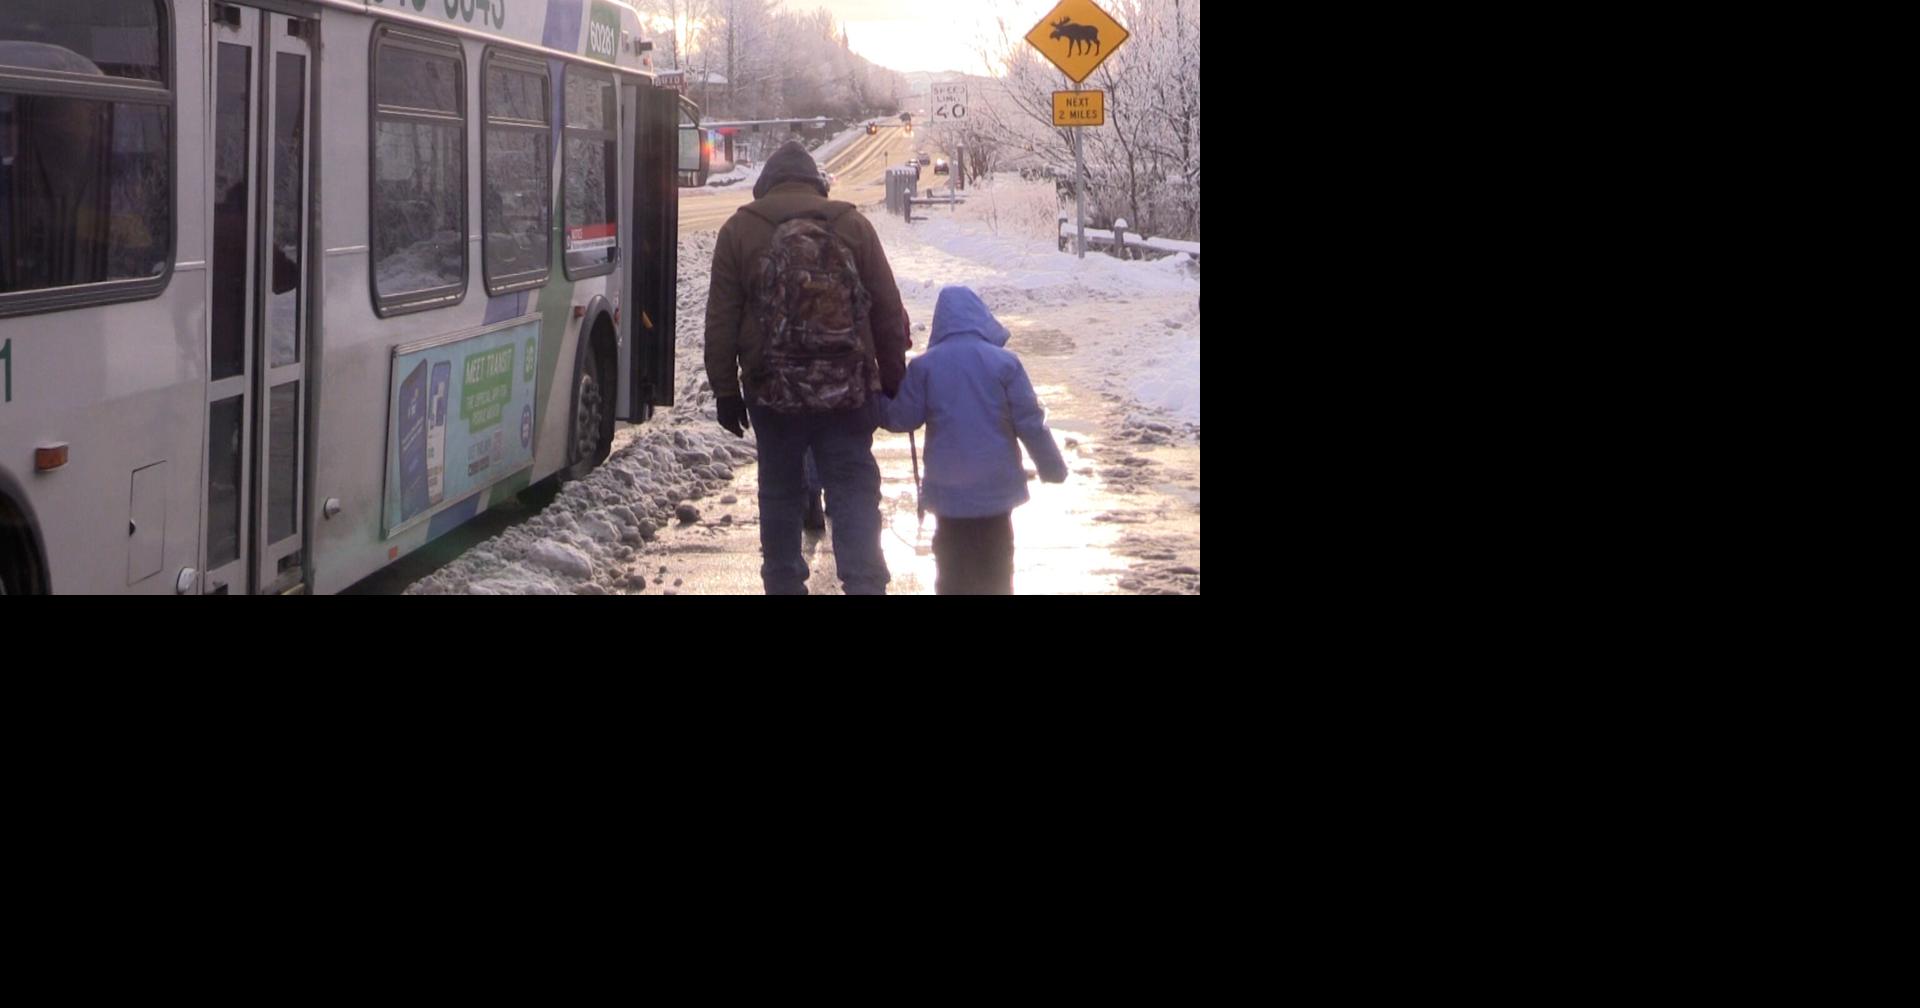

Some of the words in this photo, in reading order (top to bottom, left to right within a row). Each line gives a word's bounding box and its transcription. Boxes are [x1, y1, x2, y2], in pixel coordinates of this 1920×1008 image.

[590, 21, 616, 56] 60281
[936, 103, 965, 119] 40
[1066, 97, 1089, 107] NEXT
[1058, 110, 1065, 120] 2
[1070, 109, 1098, 120] MILES
[0, 338, 12, 402] 1
[465, 357, 486, 385] MEET
